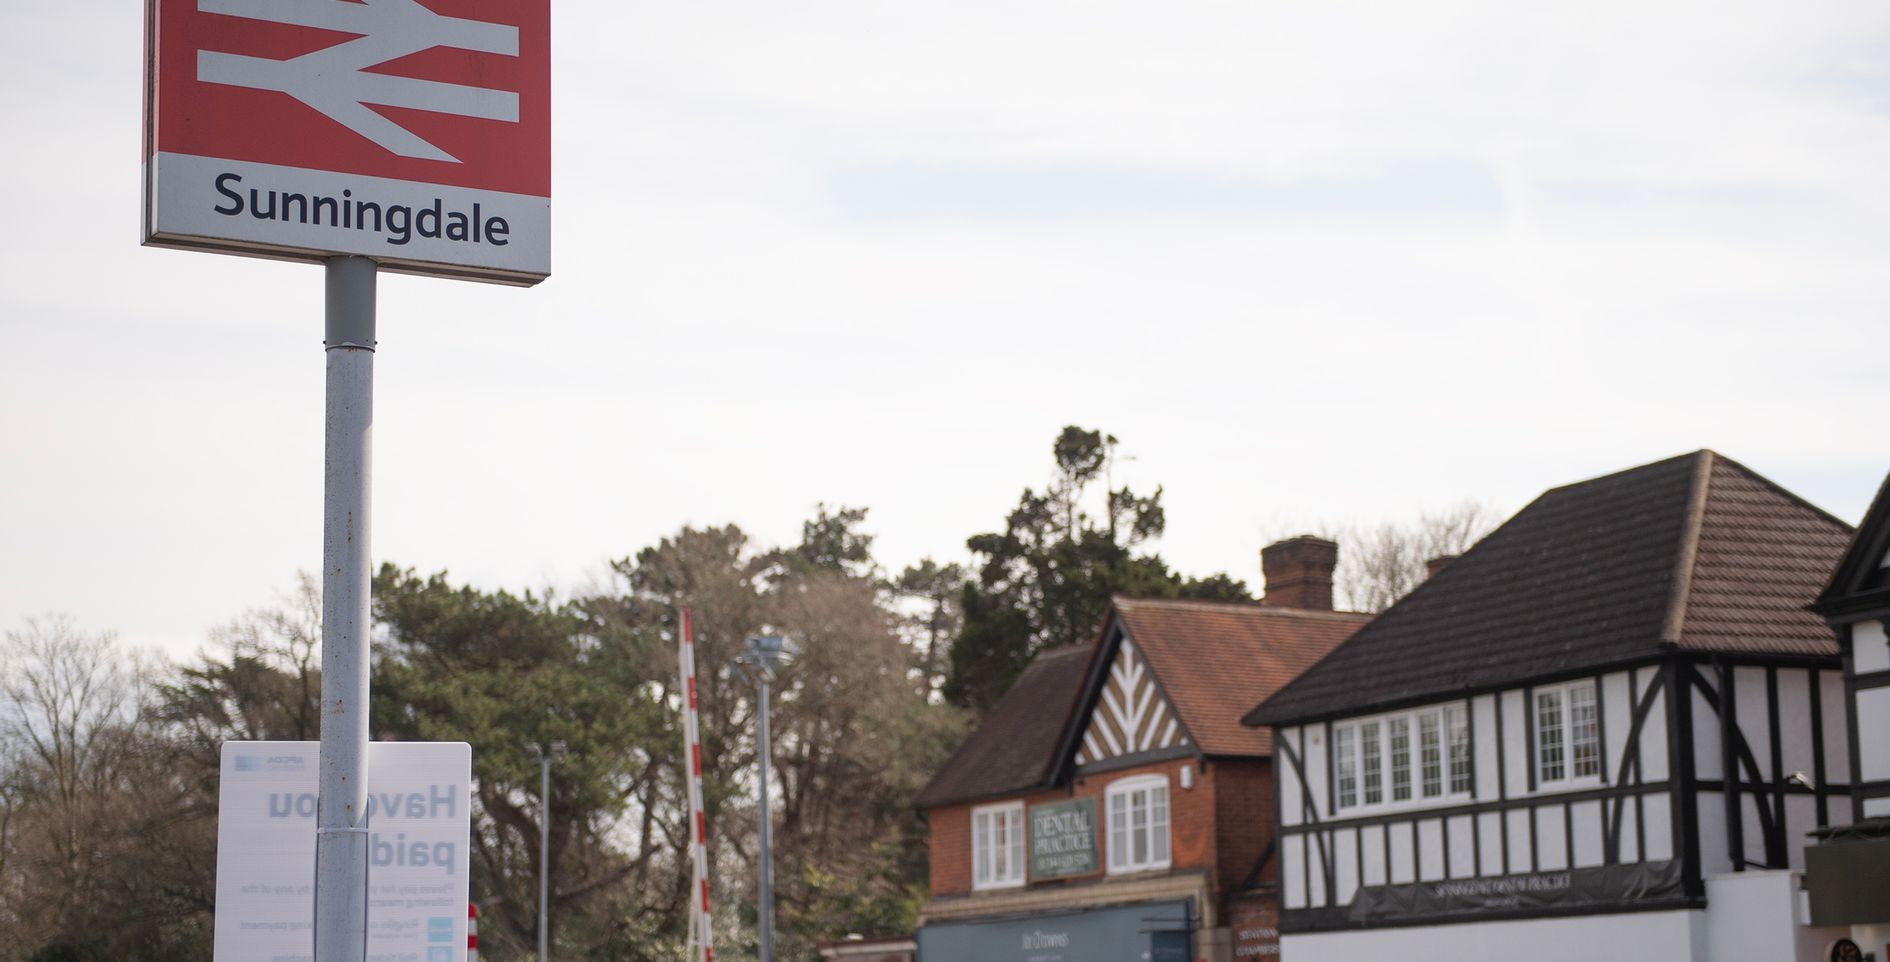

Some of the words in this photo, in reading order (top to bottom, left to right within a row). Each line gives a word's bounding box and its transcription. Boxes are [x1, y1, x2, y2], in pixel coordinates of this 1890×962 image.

[214, 172, 510, 246] Sunningdale
[1034, 810, 1092, 838] DENTAL
[1033, 832, 1091, 856] PRACTICE
